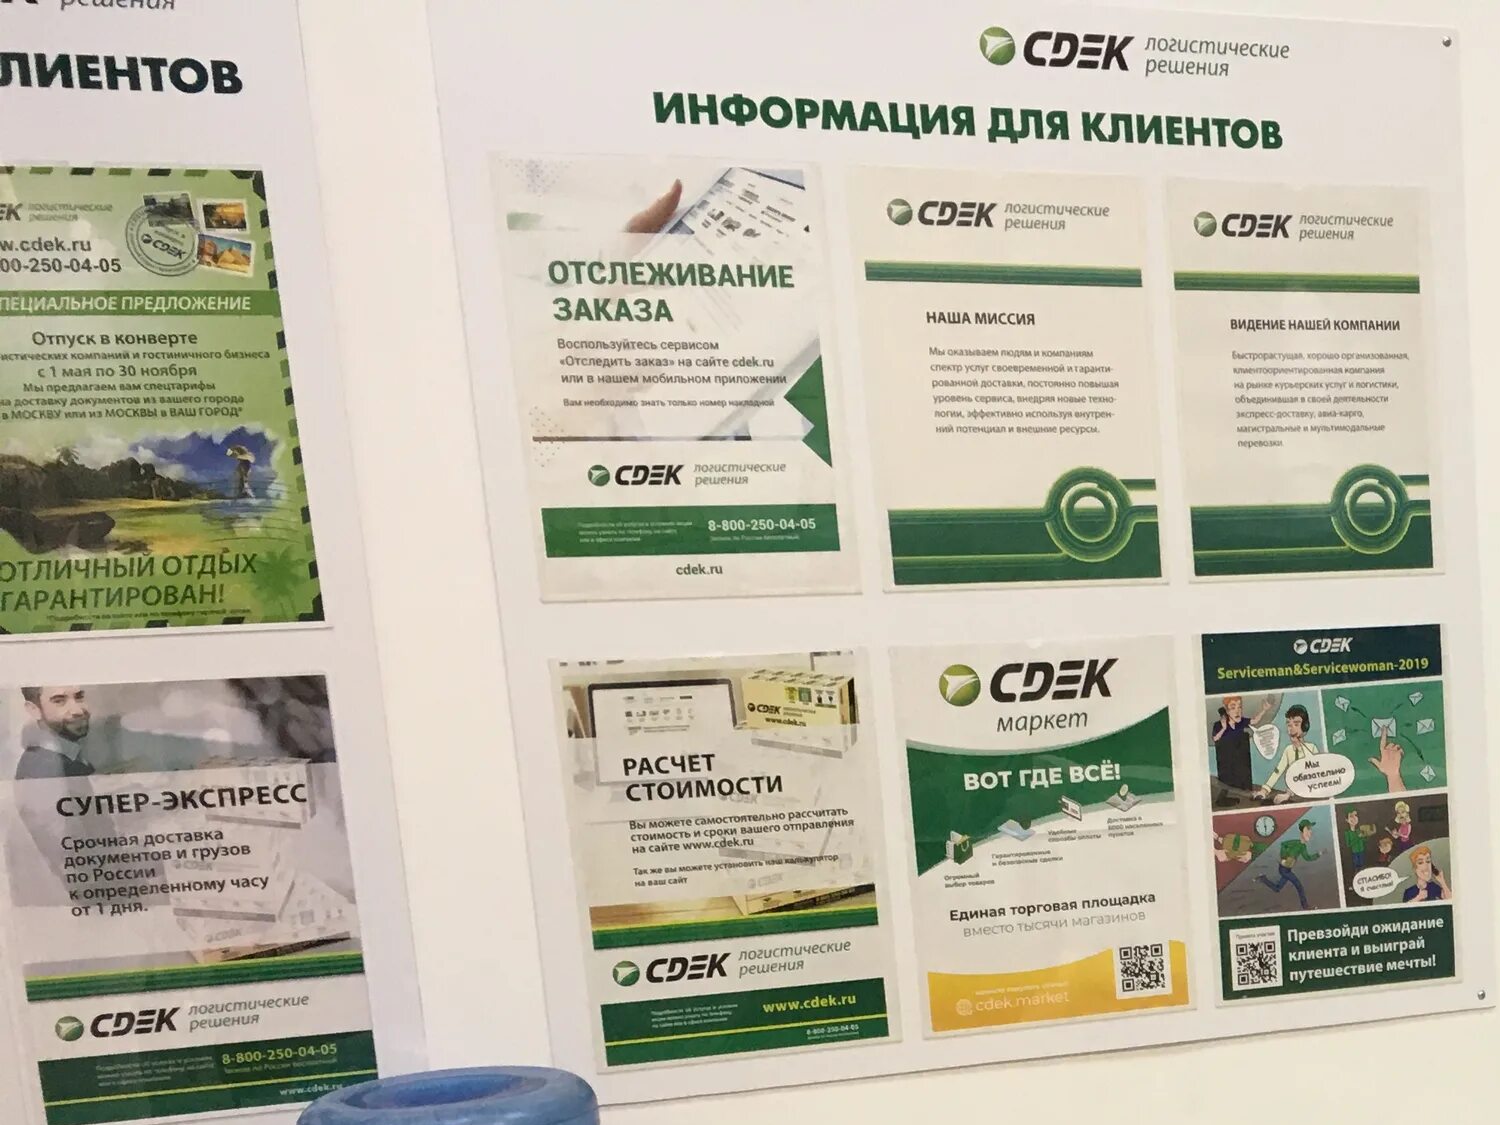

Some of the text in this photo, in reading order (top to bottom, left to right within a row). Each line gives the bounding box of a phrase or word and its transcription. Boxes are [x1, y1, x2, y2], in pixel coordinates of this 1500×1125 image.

[1023, 31, 1135, 71] CDEK
[1145, 36, 1290, 58] логистические
[1145, 57, 1229, 77] решения
[653, 91, 1283, 150] ИНФОРМАЦИЯ ДЛЯ КЛИЕНТОВ
[918, 201, 997, 228] CDEK
[1004, 203, 1110, 218] логистические
[1299, 214, 1394, 228] логистические
[1004, 217, 1066, 232] решения
[1221, 213, 1293, 239] CDEK
[1299, 228, 1355, 242] решения
[548, 260, 795, 288] ОТСЛЕЖИВАНИЕ
[121, 296, 251, 312] ПРЕДЛОЖЕНИЕ
[552, 297, 674, 322] ЗАКАЗА
[926, 311, 1036, 326] НАША МИССИЯ
[1230, 318, 1400, 333] ВИДЕНИЕ НАШЕЙ КОМПАНИИ
[32, 332, 198, 348] Отпуск в конверте
[557, 338, 719, 353] Воспользуйтесь сервисом
[37, 365, 197, 380] с 1 мая по 30 ноября
[560, 356, 774, 369] «Отследить заказ» на сайте cdek.ru
[561, 372, 787, 387] или в нашем мобильном приложении
[615, 464, 684, 486] CDEK
[708, 519, 816, 533] 8-800-250-04-05
[0, 551, 257, 582] ОТЛИЧНЫЙ ОТДЫХ
[675, 563, 723, 577] cdek.ru
[1, 584, 224, 612] ГАРАНТИРОВАН!
[1310, 637, 1354, 653] CDEK
[1217, 657, 1429, 680] Serviceman&Servicewoman-2019
[990, 658, 1119, 703] CDEK
[996, 711, 1089, 736] маркет
[622, 753, 716, 777] РАСЧЕТ
[963, 760, 1121, 791] ВОТ ГДЕ ВСЁ!
[1293, 767, 1346, 782] обязательно
[1305, 760, 1320, 769] Мы
[625, 775, 783, 803] СТОИМОСТИ
[1307, 777, 1342, 792] успеем!
[56, 783, 307, 818] СУПЕР-ЭКСПРЕСС
[629, 807, 849, 831] Вы можете самостоятельно рассчитать
[61, 828, 224, 852] Срочная доставка
[630, 830, 694, 843] стоимость
[704, 827, 737, 840] сроки
[740, 824, 780, 836] вашего
[783, 818, 855, 834] отправления
[632, 836, 754, 854] на сайте www.cdek.ru
[64, 844, 251, 870] документов и грузов
[66, 866, 156, 884] по России
[69, 876, 269, 902] к определенному часу
[71, 901, 148, 918] от 1 дня.
[949, 893, 1156, 922] Единая торговая площадка
[963, 910, 1146, 938] вместо тысячи магазинов
[1287, 917, 1444, 944] Превзойди ожидание
[738, 940, 851, 962] логистические
[1288, 935, 1426, 963] клиента и выиграй
[646, 952, 731, 983] CDEK
[738, 958, 804, 979] решения
[1289, 953, 1437, 984] путешествие мечты!
[187, 994, 310, 1016] логистические
[763, 994, 857, 1014] www.cdek.ru
[975, 991, 1070, 1013] cdek.market
[90, 1006, 181, 1038] CDEK
[189, 1013, 260, 1033] решения
[222, 1043, 338, 1066] 8-800-250-04-05
